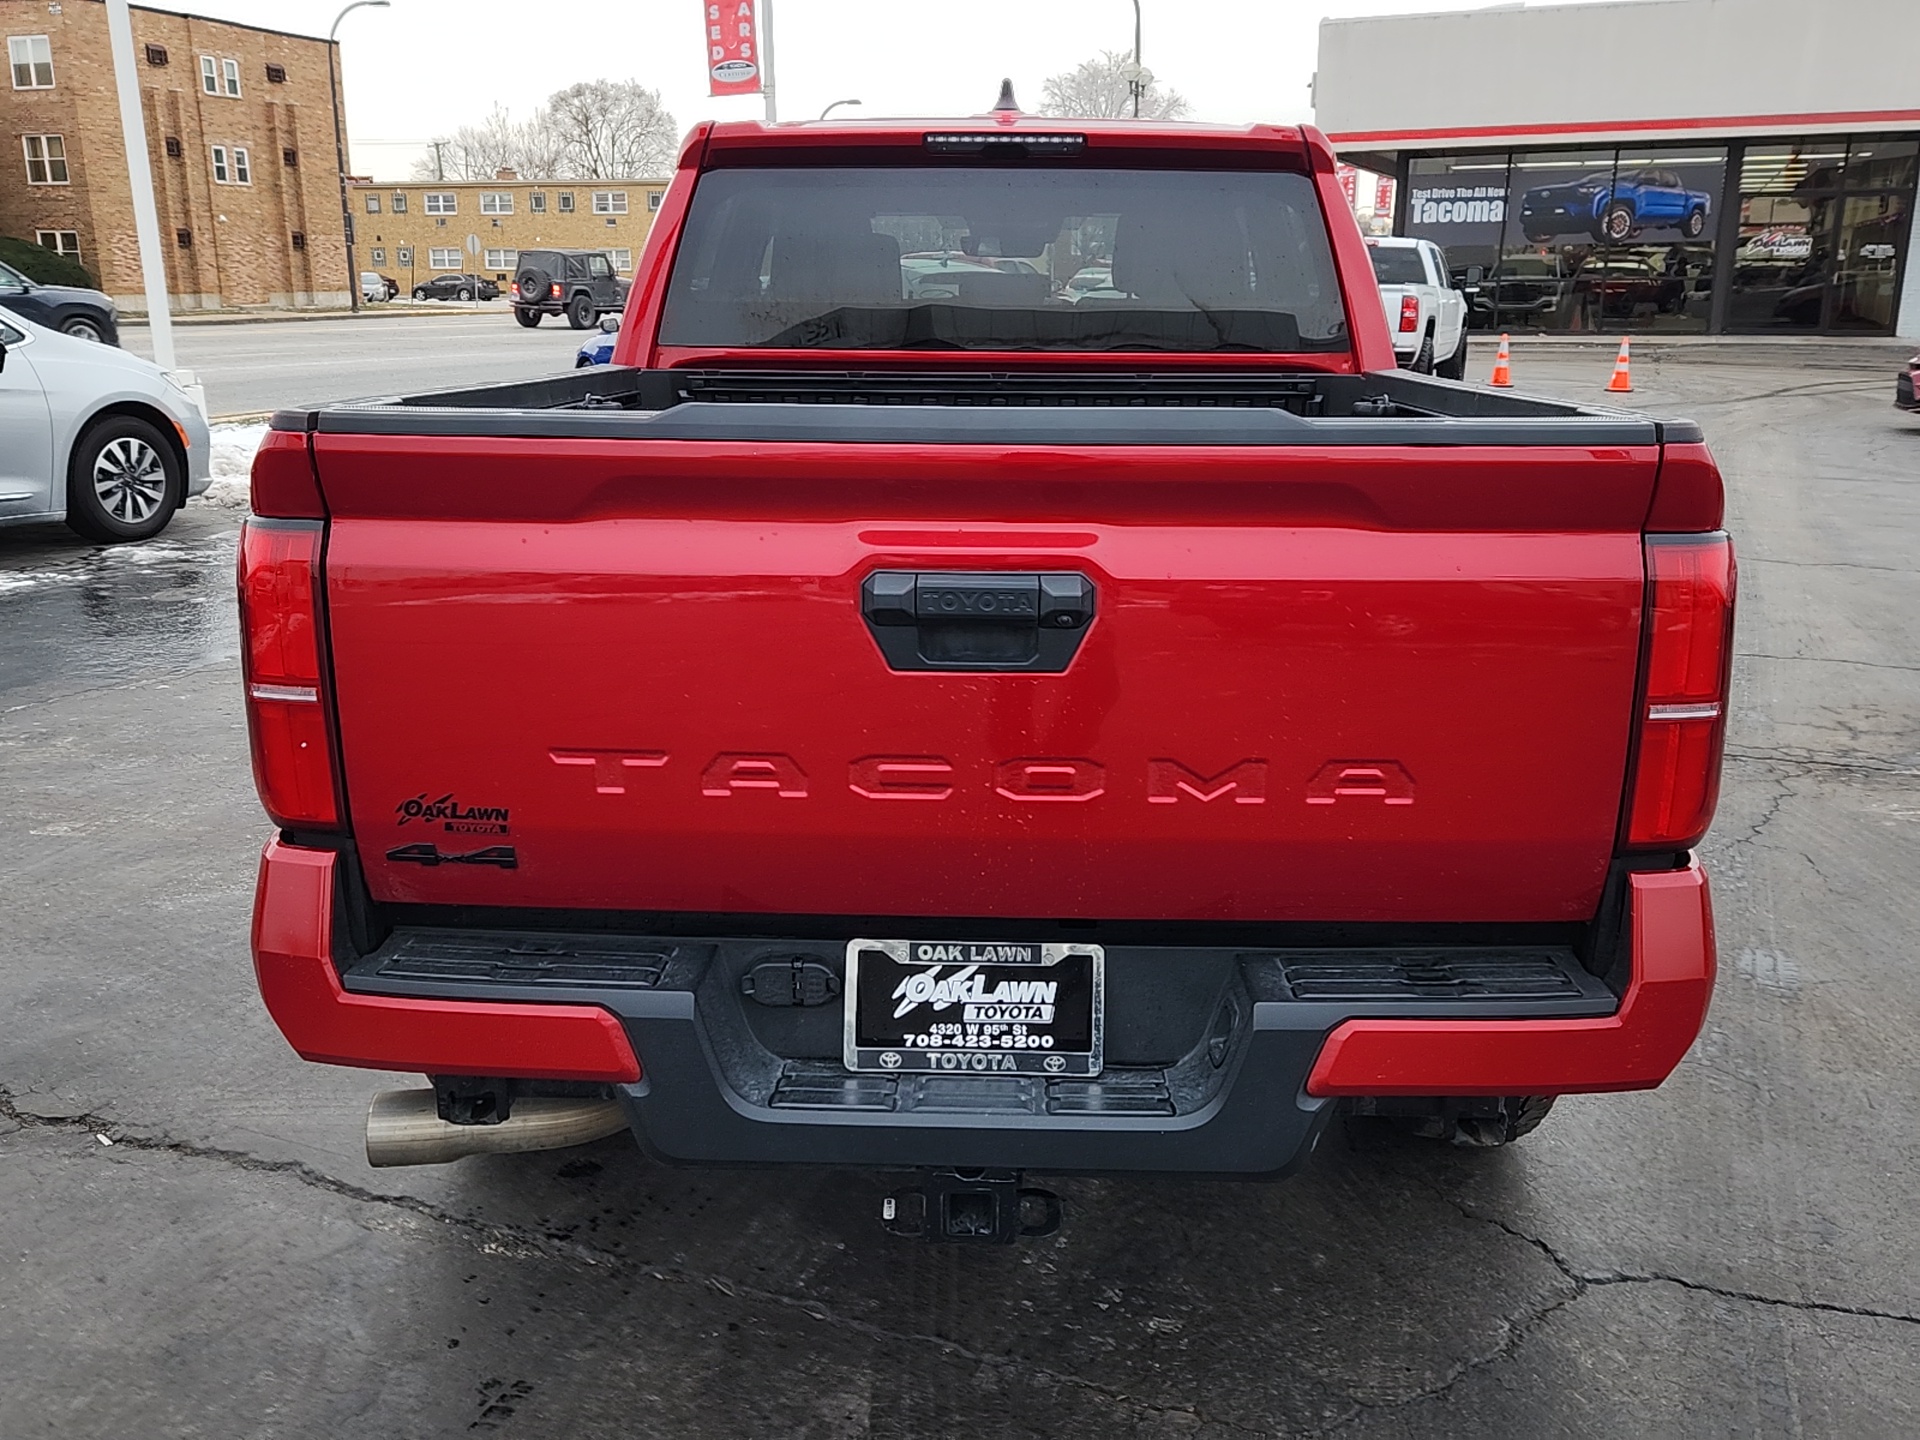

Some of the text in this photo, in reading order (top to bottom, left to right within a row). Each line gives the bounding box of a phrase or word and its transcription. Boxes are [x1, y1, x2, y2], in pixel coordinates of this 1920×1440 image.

[1412, 189, 1431, 198] Test
[1432, 188, 1456, 198] Drive
[1456, 188, 1473, 197] The
[1473, 187, 1486, 197] All
[1411, 198, 1504, 223] Tacoma
[921, 591, 1035, 612] TOYOTA
[548, 746, 1416, 806] TACOMA
[451, 823, 501, 833] TOYOTA
[917, 945, 1031, 962] OAK LAWN
[973, 1005, 1044, 1019] TOYOTA
[929, 1023, 962, 1035] 4320
[966, 1023, 979, 1035] W
[1012, 1024, 1028, 1035] St
[903, 1034, 1054, 1048] 708-423-5200
[926, 1052, 1017, 1071] TOYOTA
